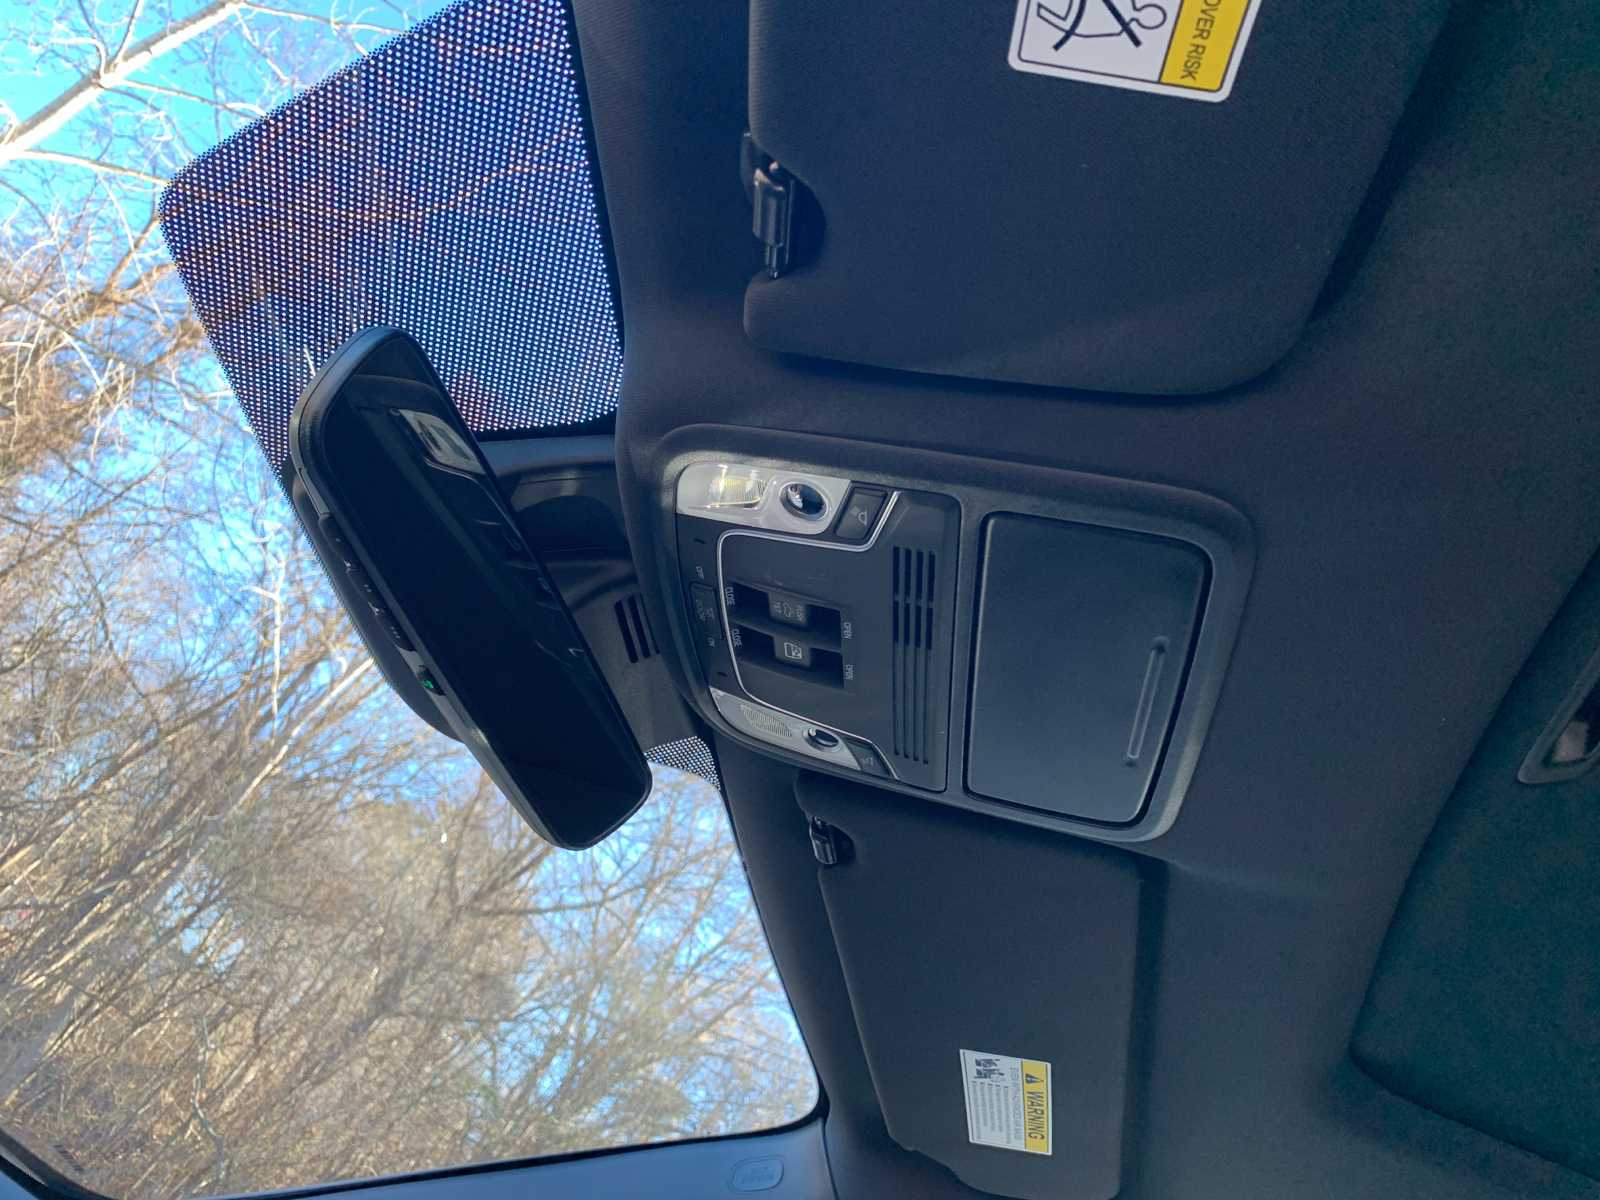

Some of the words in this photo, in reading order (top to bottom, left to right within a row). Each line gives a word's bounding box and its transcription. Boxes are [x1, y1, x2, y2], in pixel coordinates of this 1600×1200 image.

[1180, 43, 1207, 81] RISK
[696, 566, 704, 579] OFF
[725, 587, 735, 606] CLOSE
[695, 599, 705, 621] DOOR
[773, 602, 781, 613] TILT
[795, 605, 804, 621] PUSH
[732, 629, 742, 647] CLOSE
[843, 622, 852, 639] OPEN
[708, 637, 716, 647] ON
[845, 664, 854, 680] OPEN
[1010, 1067, 1019, 1081] EVEN
[1011, 1082, 1020, 1094] WITH
[1012, 1095, 1021, 1119] ADVANCED
[1013, 1119, 1021, 1127] AIR
[1027, 1091, 1045, 1140] WARNING
[1013, 1128, 1022, 1140] BAGS
